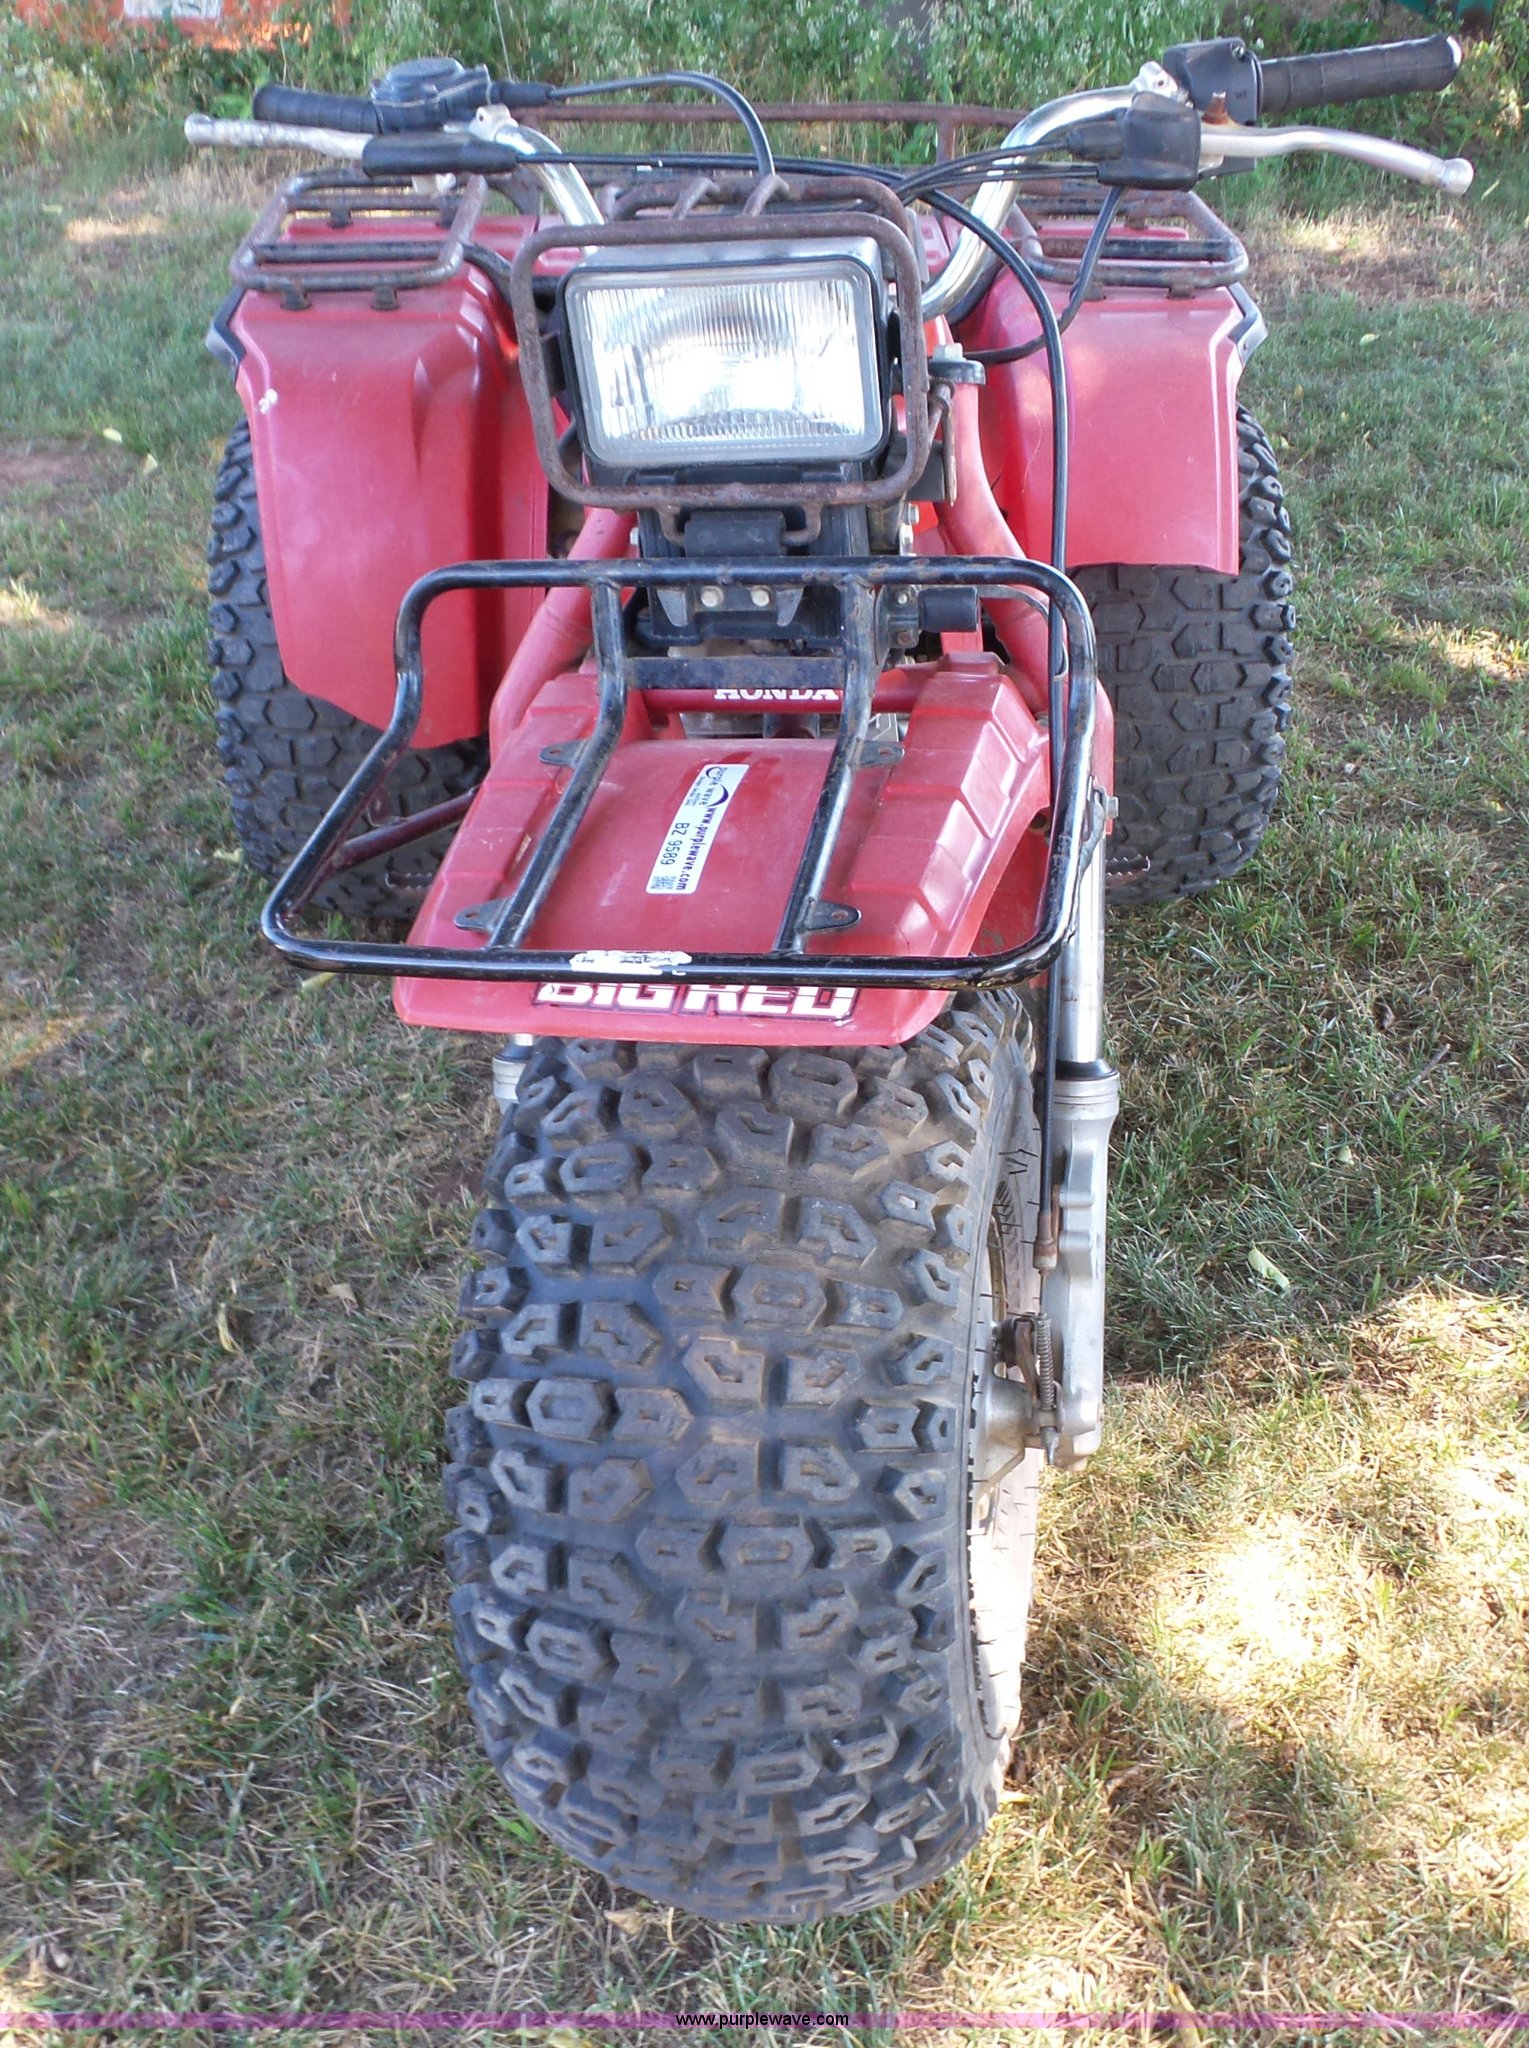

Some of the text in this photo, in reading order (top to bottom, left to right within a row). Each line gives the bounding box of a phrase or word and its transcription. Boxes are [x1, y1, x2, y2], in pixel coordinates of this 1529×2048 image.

[660, 822, 691, 865] BZ 9589
[675, 807, 717, 891] www.purplewave.com
